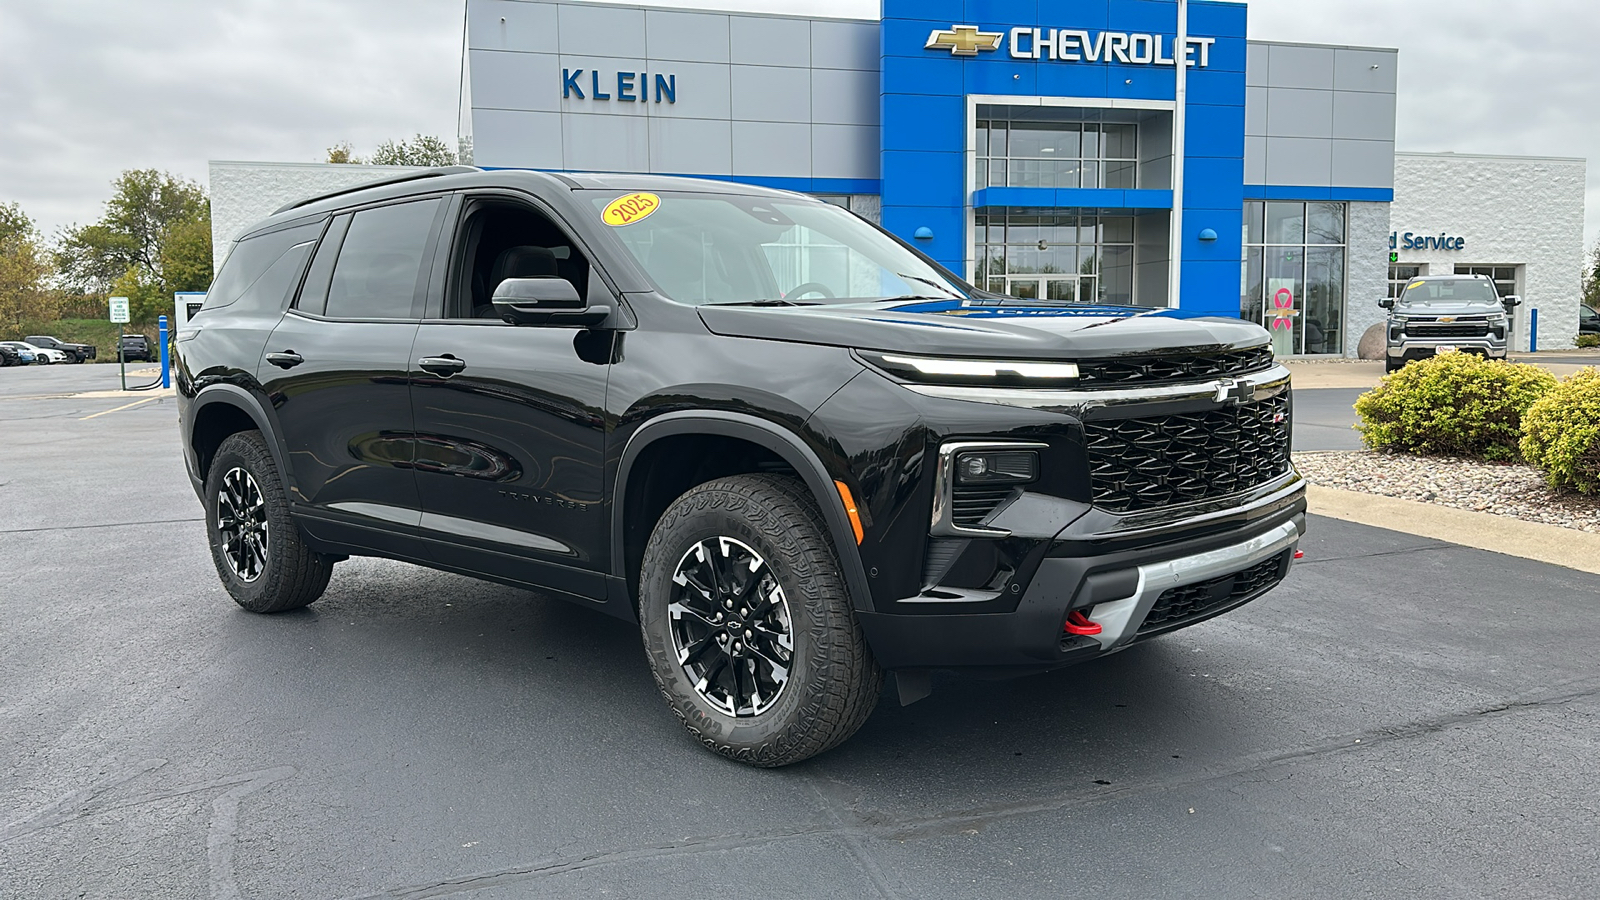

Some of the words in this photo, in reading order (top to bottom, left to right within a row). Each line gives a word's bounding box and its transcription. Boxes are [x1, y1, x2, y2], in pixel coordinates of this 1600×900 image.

[1010, 27, 1216, 67] CHEVROLET
[562, 68, 676, 104] KLEIN
[611, 194, 654, 222] 2025
[1402, 232, 1465, 250] Service
[498, 490, 588, 512] TRAVERSE
